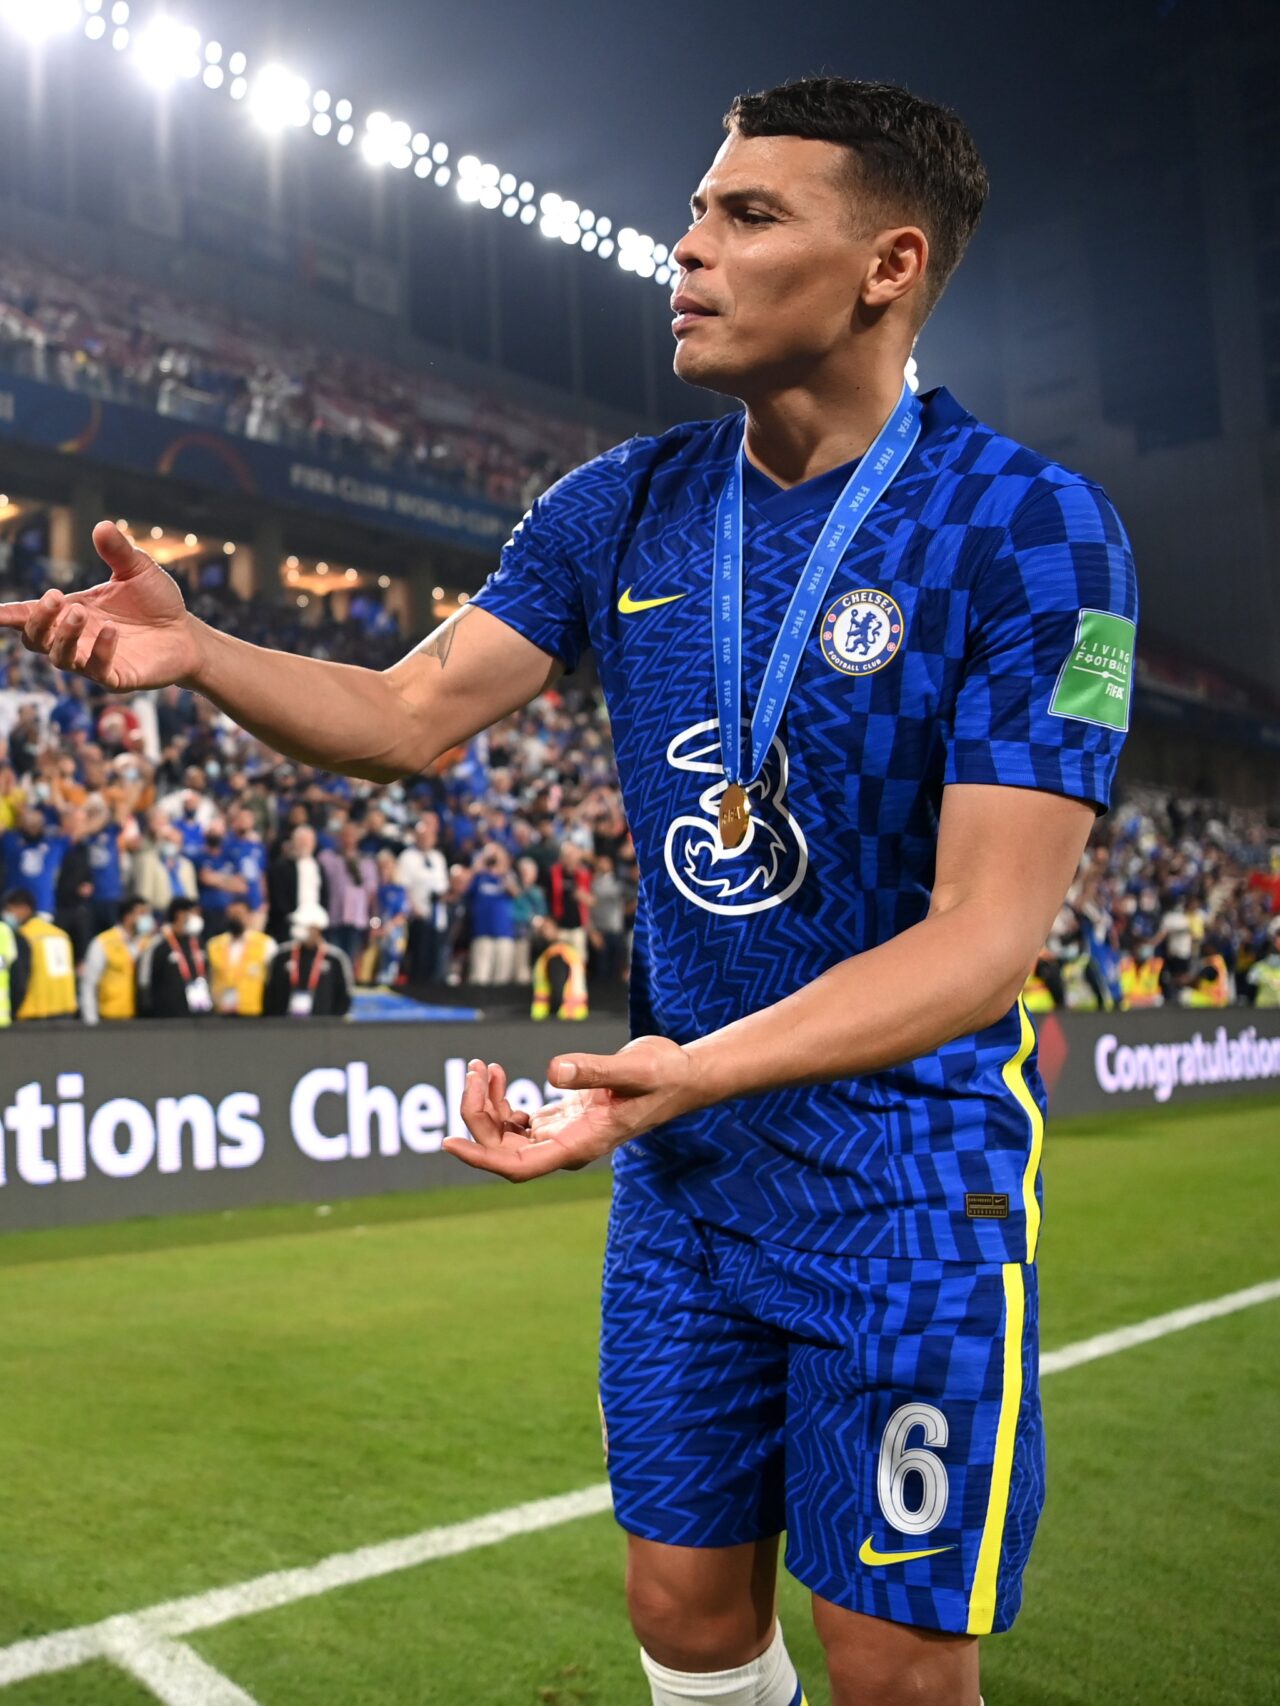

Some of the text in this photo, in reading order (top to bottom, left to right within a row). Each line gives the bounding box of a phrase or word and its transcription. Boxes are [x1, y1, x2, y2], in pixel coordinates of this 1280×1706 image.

[897, 411, 913, 436] FIFA
[873, 447, 894, 474] FIFA
[849, 485, 870, 511] FIFA
[723, 514, 732, 539] FIFA
[827, 524, 846, 551] FIFA
[723, 554, 732, 580] FIFA
[807, 565, 825, 592] FIFA
[722, 594, 730, 621] FIFA
[842, 592, 894, 615] CHELSEA
[790, 609, 807, 637] FIFA
[722, 637, 731, 663] FIFA
[828, 651, 882, 671] FOOTBALL CLUB
[1080, 641, 1130, 663] LIVING
[775, 653, 790, 680] FIFA
[1075, 652, 1127, 675] FOOTBALL
[723, 680, 731, 706] FIFA
[1105, 682, 1125, 700] FIFA
[762, 697, 776, 724] FIFA
[725, 723, 733, 750] FIFA
[877, 1402, 949, 1535] 6
